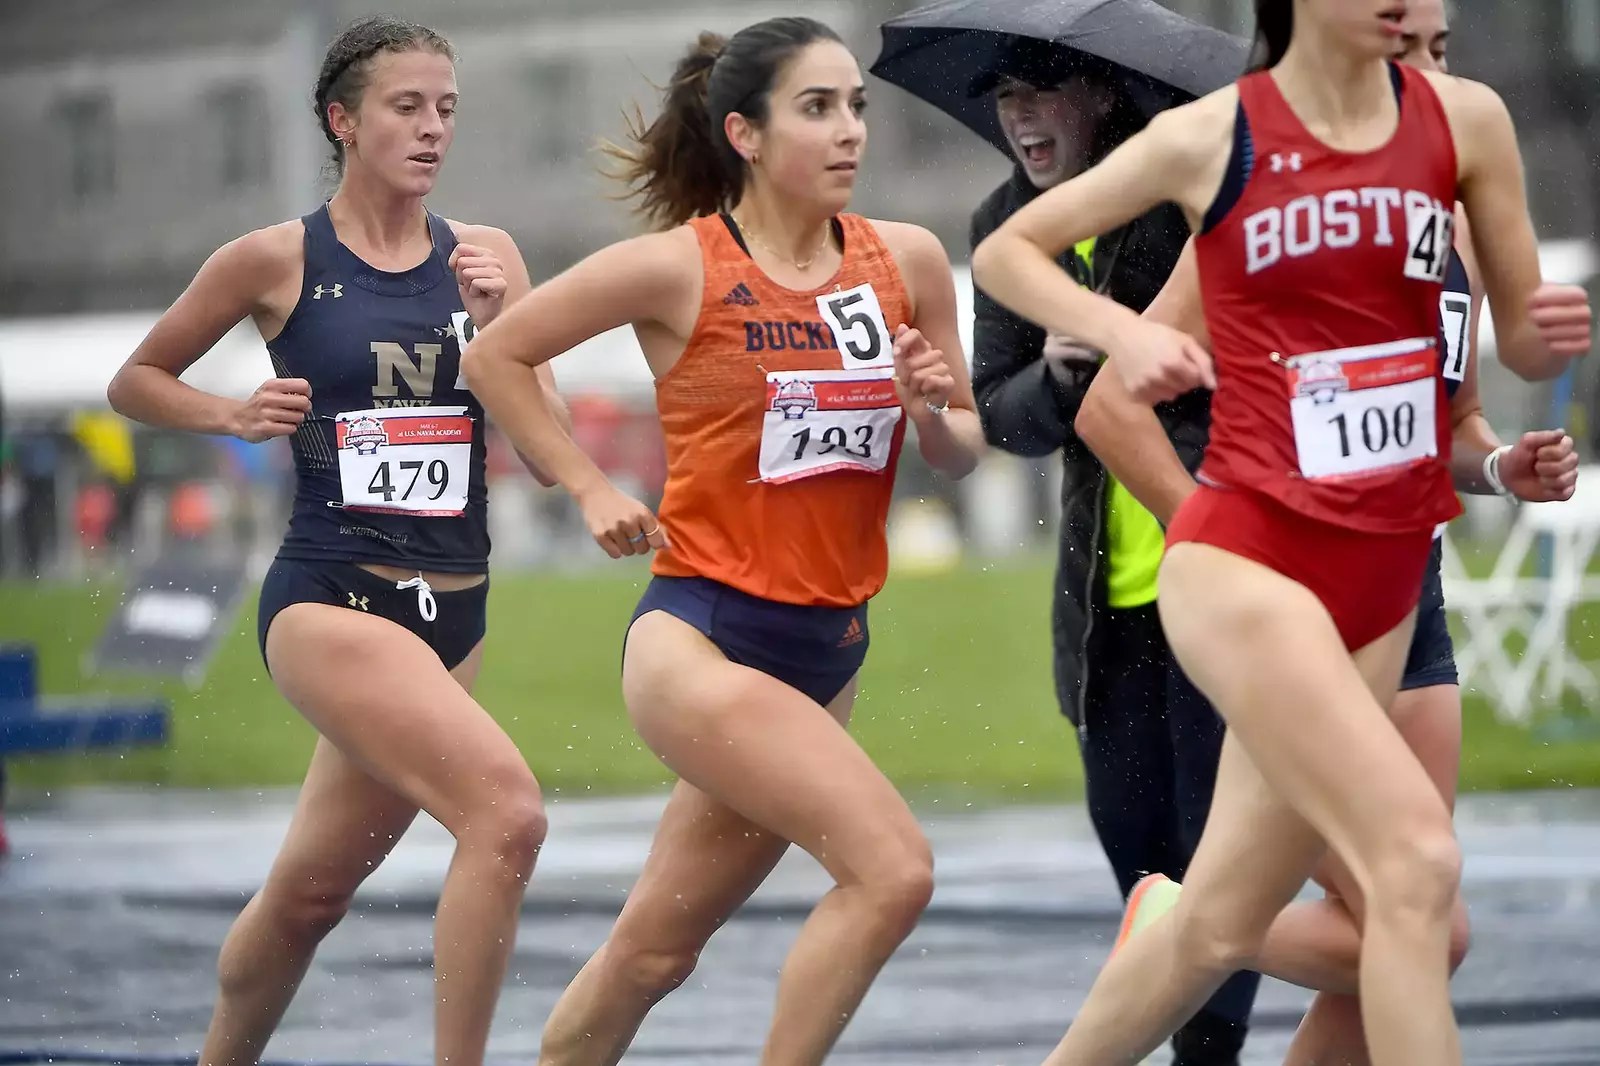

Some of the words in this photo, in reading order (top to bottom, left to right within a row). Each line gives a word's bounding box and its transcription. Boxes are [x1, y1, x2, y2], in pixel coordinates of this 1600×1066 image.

[1243, 187, 1442, 275] BOST
[744, 320, 839, 352] BUCK
[828, 293, 881, 361] 5
[370, 341, 442, 397] N
[1328, 401, 1415, 457] 100
[367, 459, 450, 502] 479
